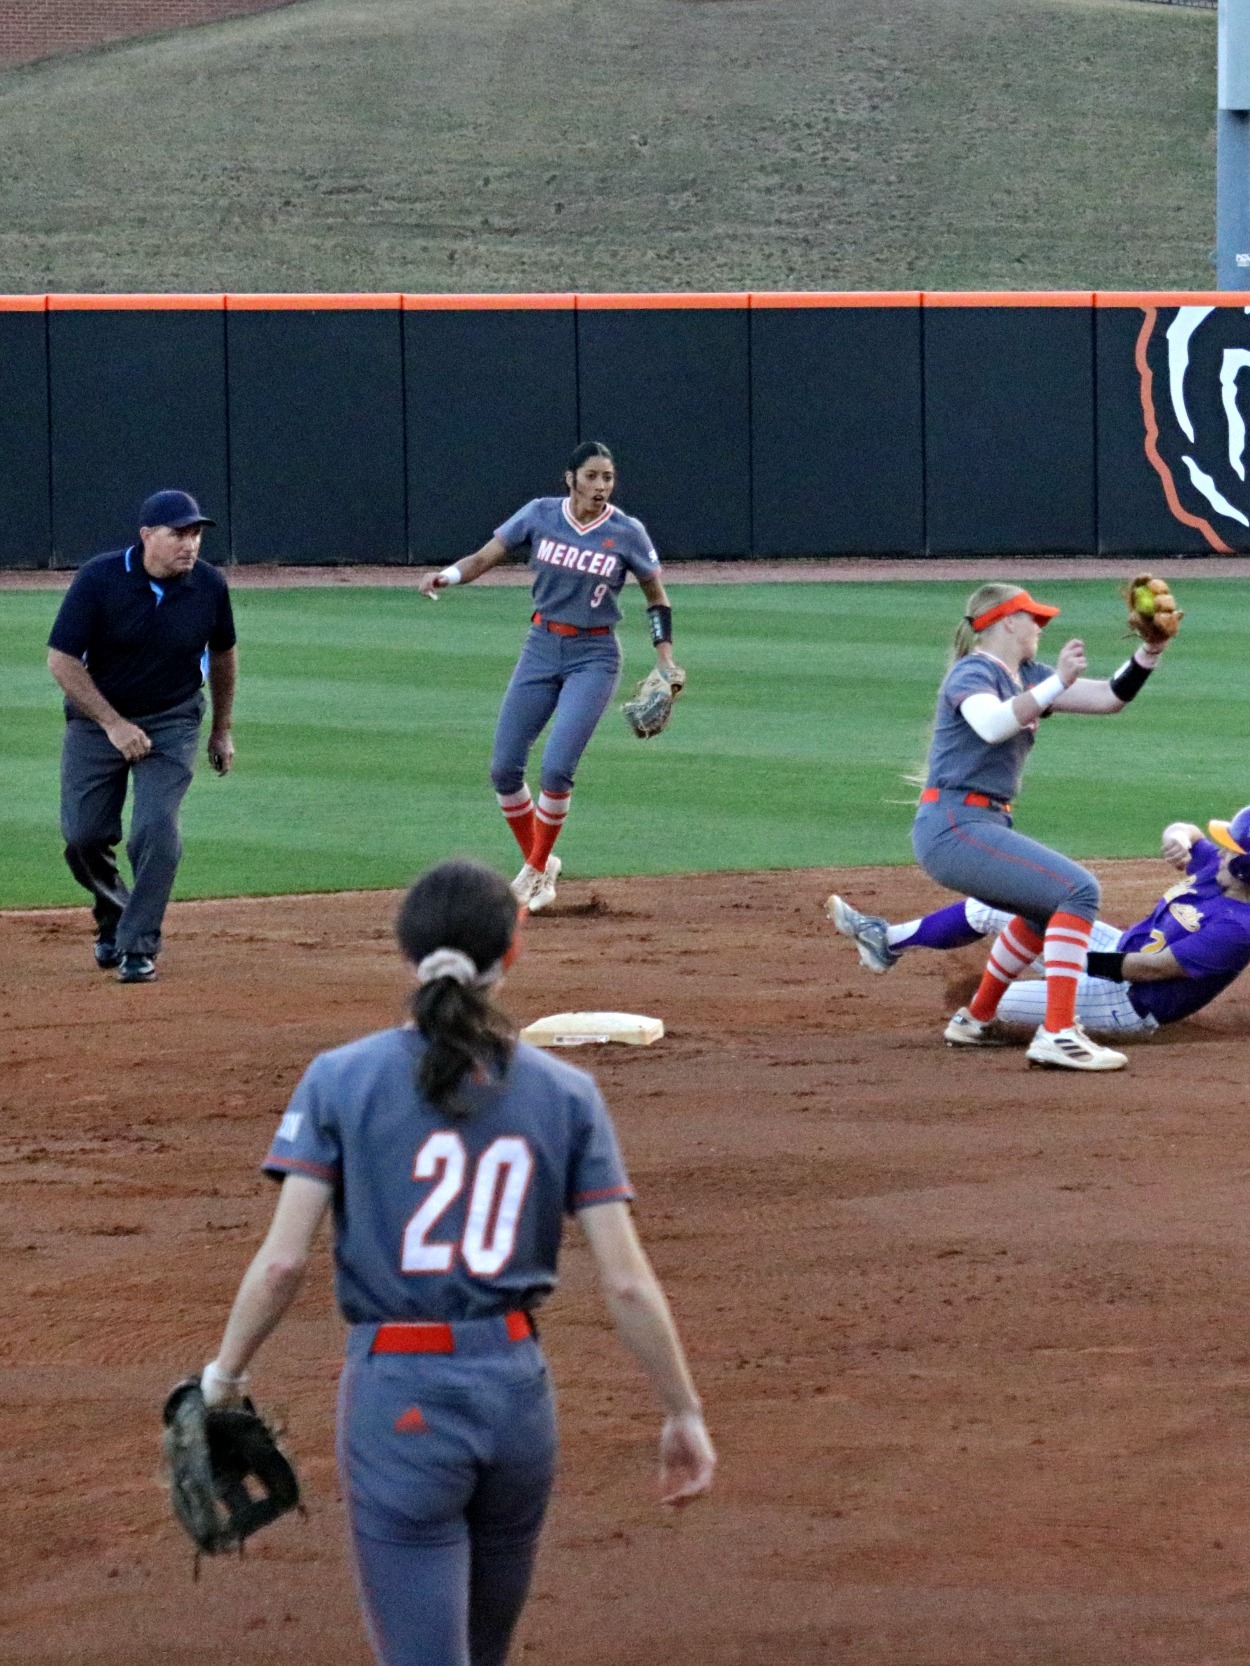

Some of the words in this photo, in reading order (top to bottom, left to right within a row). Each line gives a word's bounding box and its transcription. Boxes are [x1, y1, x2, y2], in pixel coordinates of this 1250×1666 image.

[536, 538, 617, 578] MERCER
[590, 583, 608, 609] 9
[401, 1130, 534, 1276] 20
